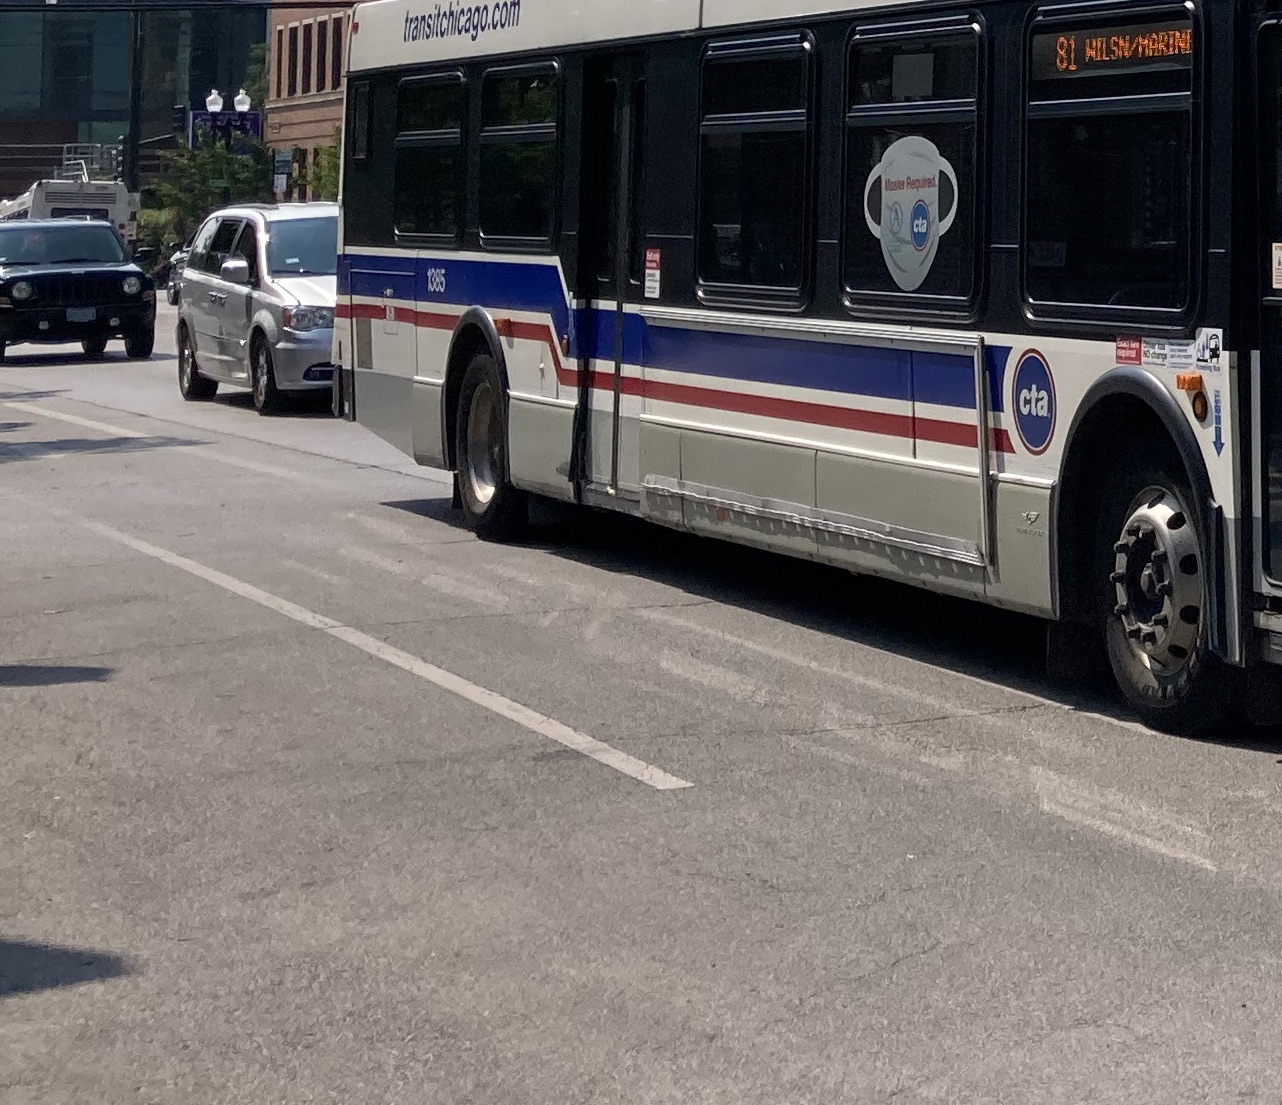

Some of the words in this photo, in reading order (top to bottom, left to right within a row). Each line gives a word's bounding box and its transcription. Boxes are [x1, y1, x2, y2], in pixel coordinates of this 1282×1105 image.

[1056, 35, 1077, 72] 81
[913, 216, 928, 234] cta
[1019, 384, 1048, 418] cta
